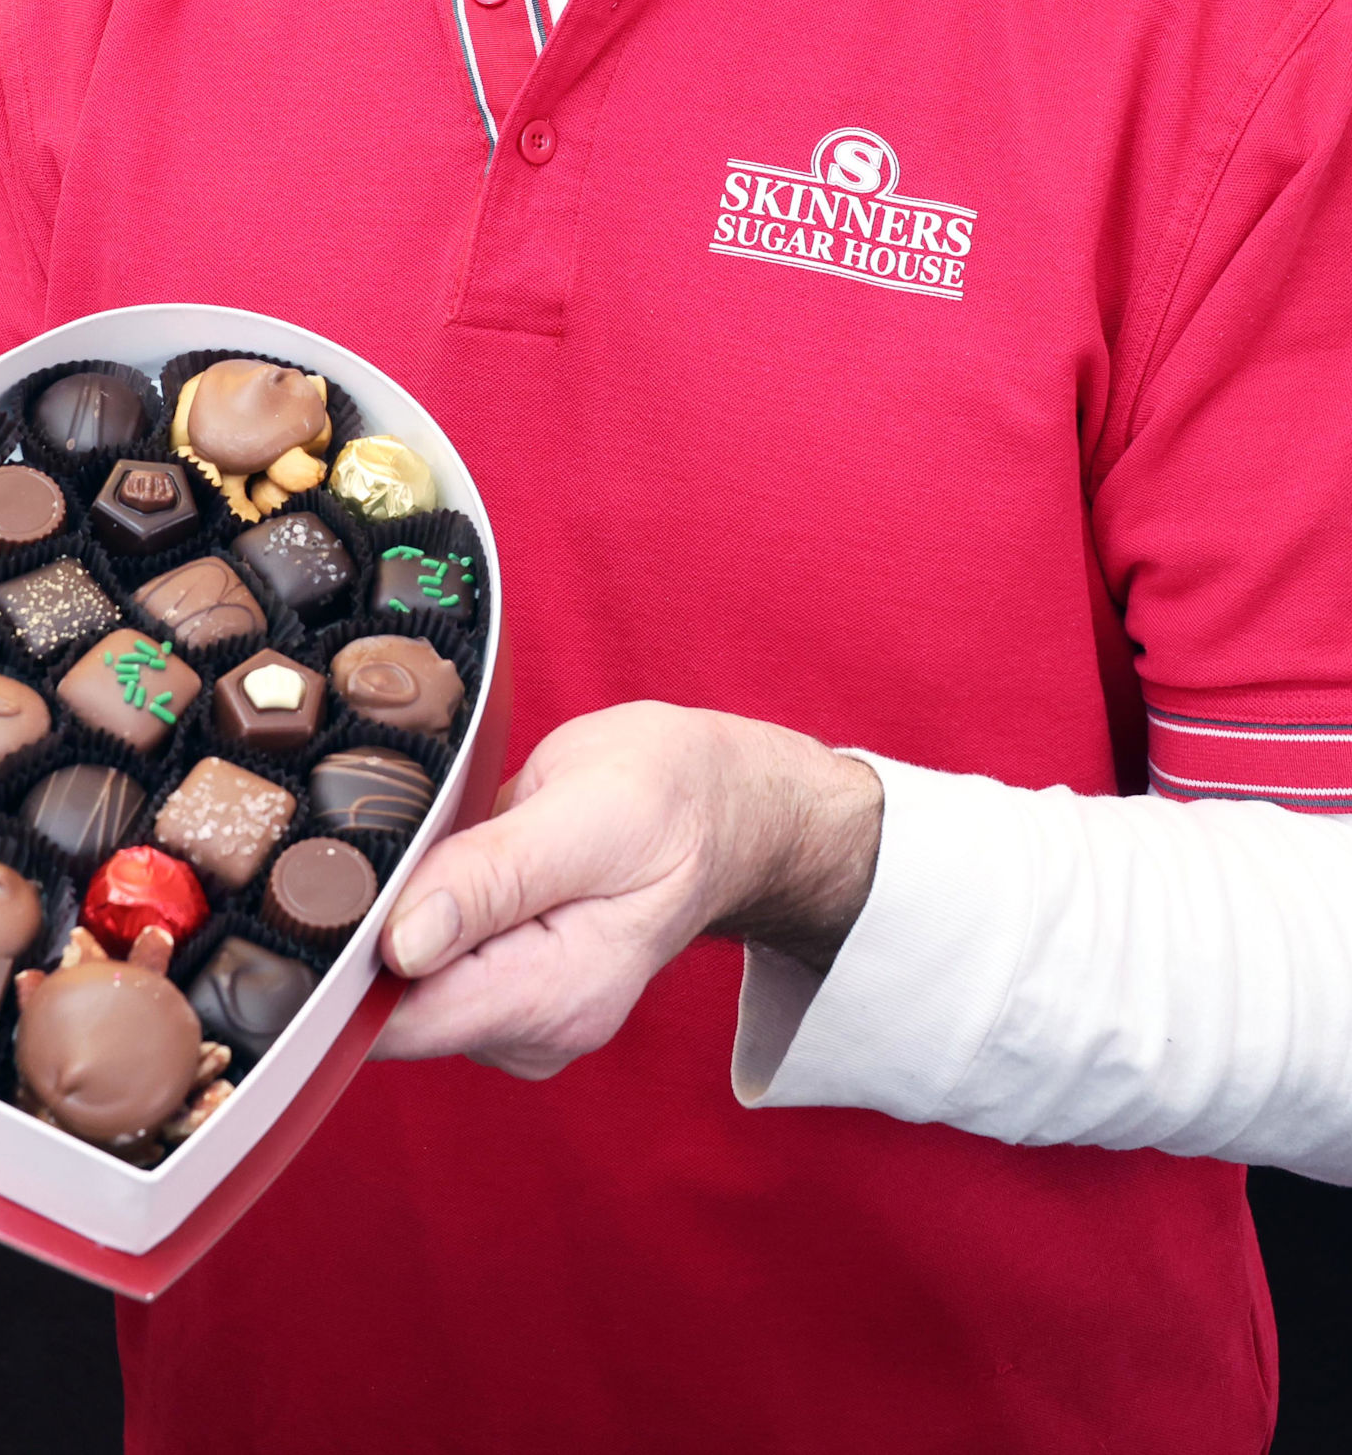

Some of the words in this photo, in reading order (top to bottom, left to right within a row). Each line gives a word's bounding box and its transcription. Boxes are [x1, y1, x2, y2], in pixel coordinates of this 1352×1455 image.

[827, 140, 884, 194] S
[713, 212, 835, 262] SUGAR
[839, 238, 966, 289] HOUSE
[719, 171, 974, 258] SKINNERS
